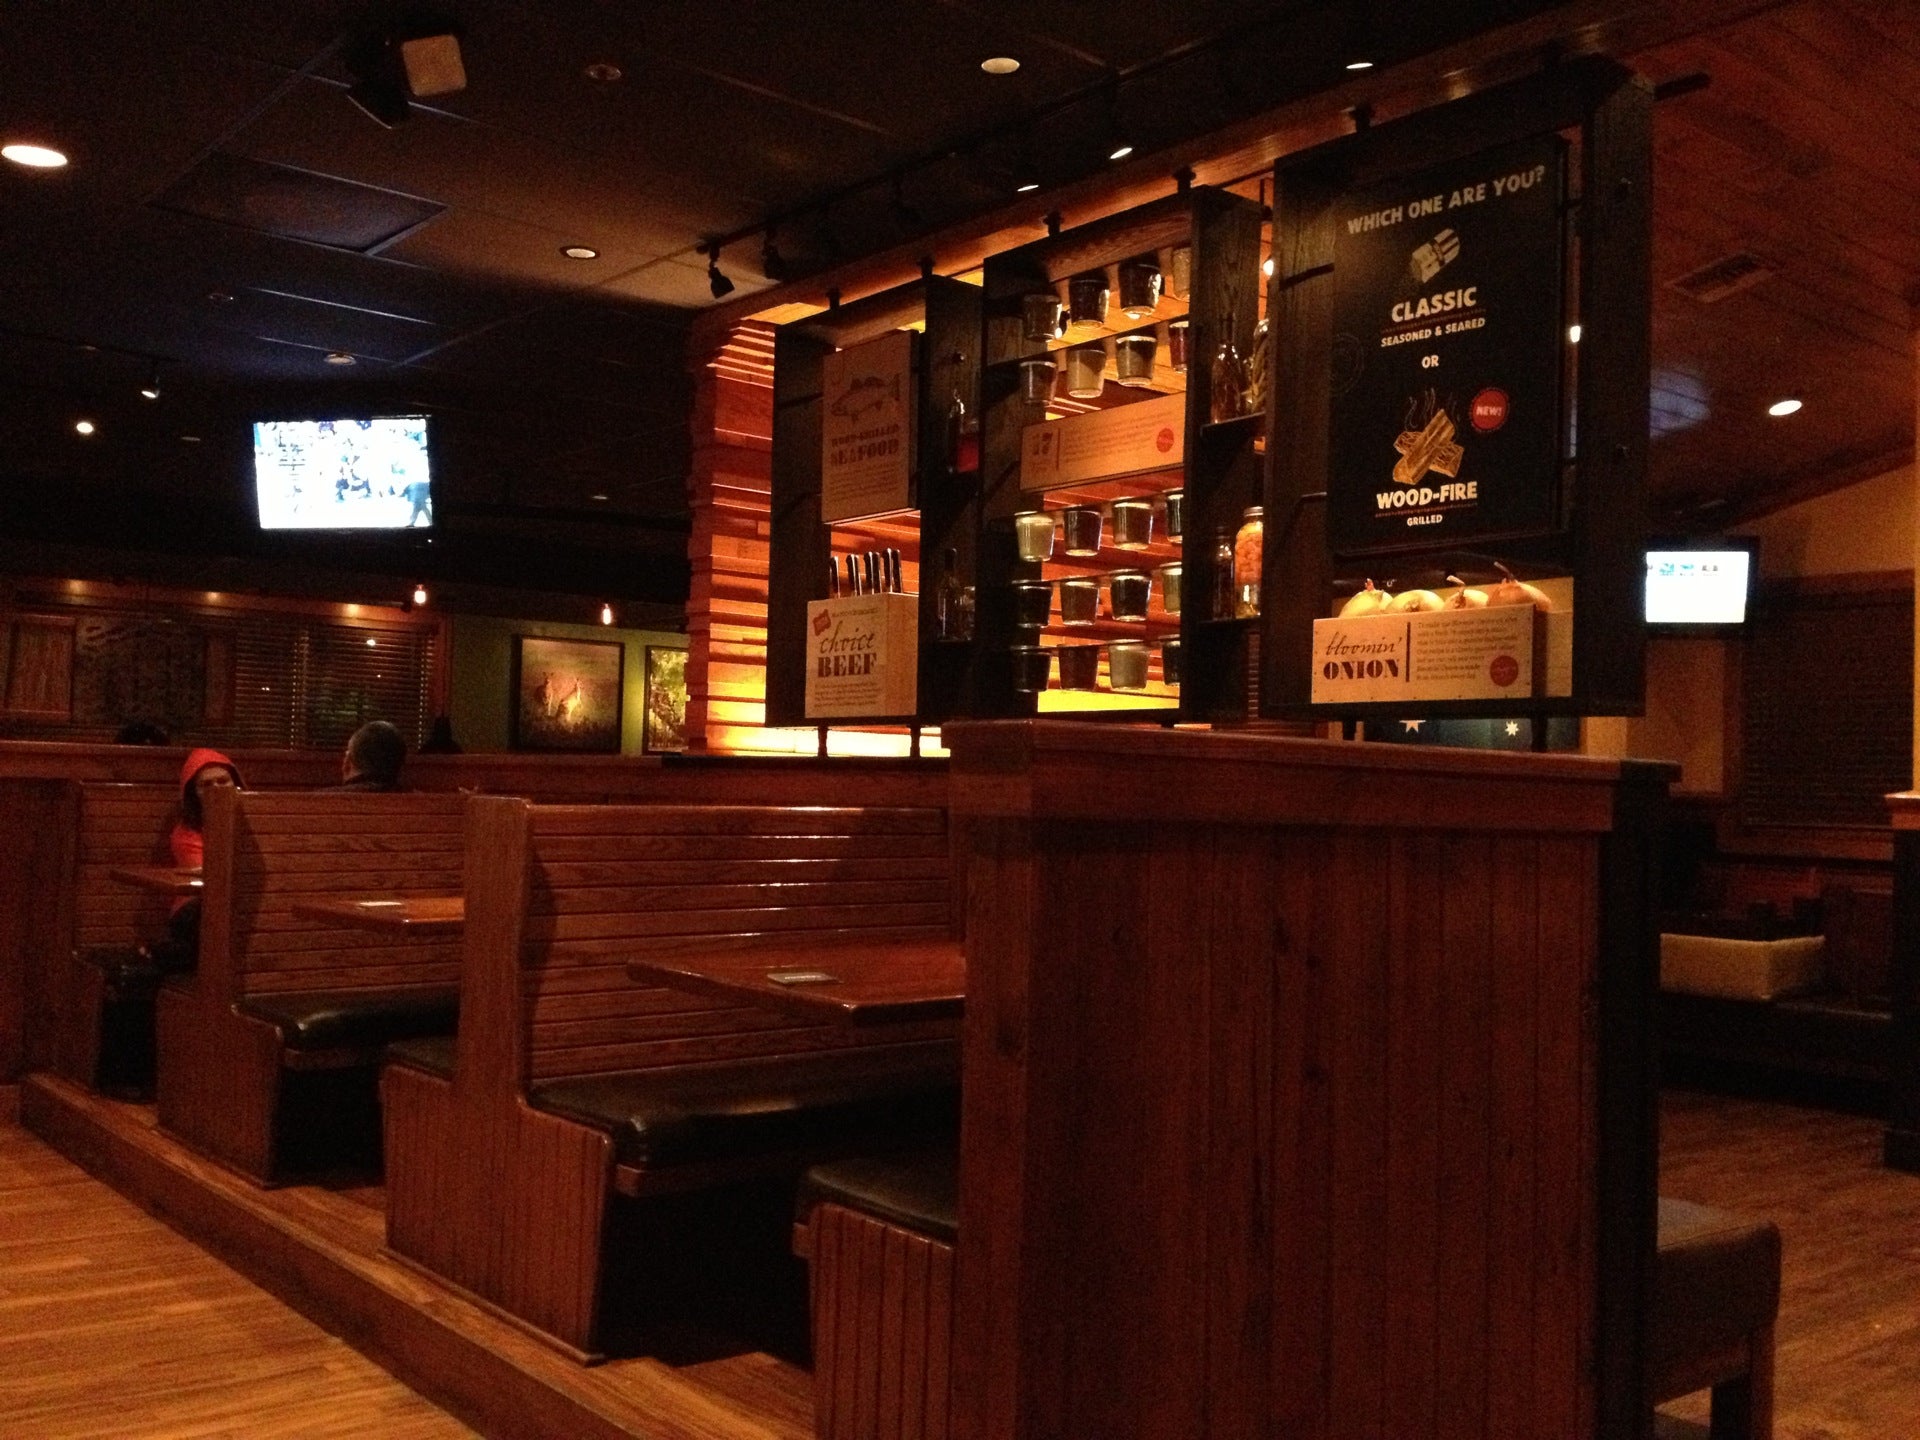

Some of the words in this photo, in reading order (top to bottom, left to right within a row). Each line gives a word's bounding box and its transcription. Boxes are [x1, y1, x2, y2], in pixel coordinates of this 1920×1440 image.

[1347, 206, 1403, 234] WHICH
[1408, 195, 1443, 219] ONE
[1449, 183, 1486, 209] ARE
[1493, 165, 1545, 196] YOU?
[1391, 287, 1477, 322] CLASSIC
[1381, 329, 1432, 347] SEASONED
[1434, 325, 1443, 336] &
[1445, 317, 1486, 334] SEARED
[1421, 354, 1439, 369] OR
[1476, 405, 1503, 417] NEW!
[1376, 481, 1478, 509] WOOD-FIRE
[1406, 514, 1443, 526] GRILLED
[819, 620, 875, 654] choice
[818, 653, 877, 678] BEEF
[1323, 658, 1400, 680] ONION
